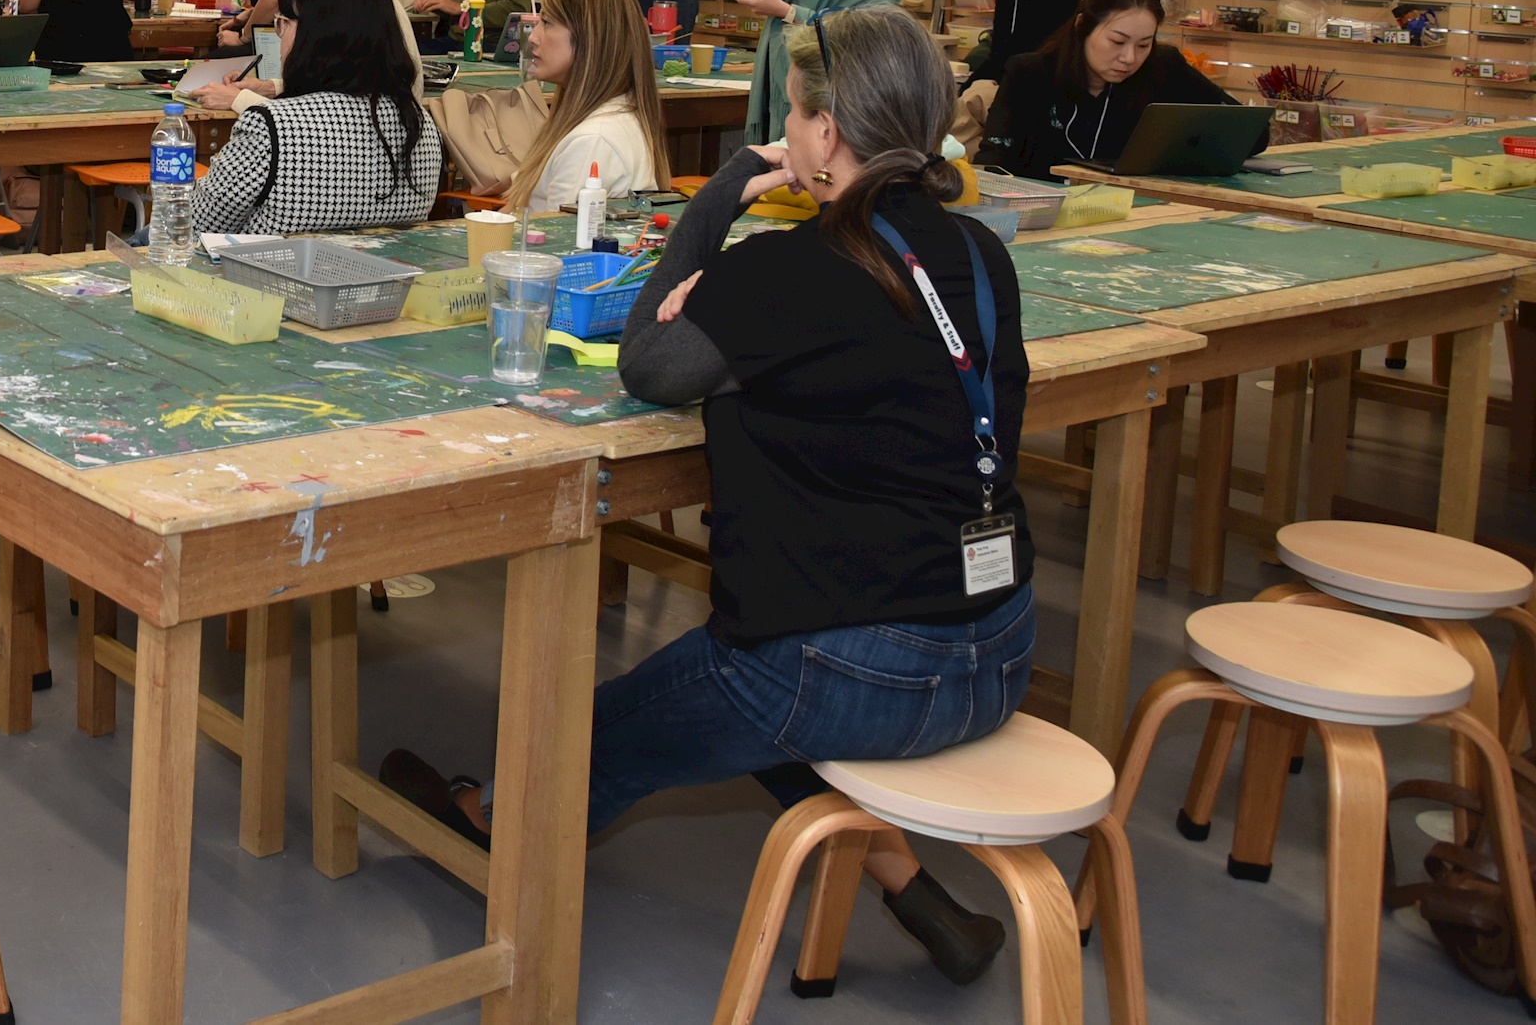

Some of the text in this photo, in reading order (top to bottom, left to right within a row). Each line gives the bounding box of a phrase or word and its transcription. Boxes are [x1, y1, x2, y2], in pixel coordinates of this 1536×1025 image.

[155, 156, 173, 166] bon
[155, 165, 177, 174] aqua
[928, 292, 944, 321] Faculty
[946, 330, 961, 351] Staff
